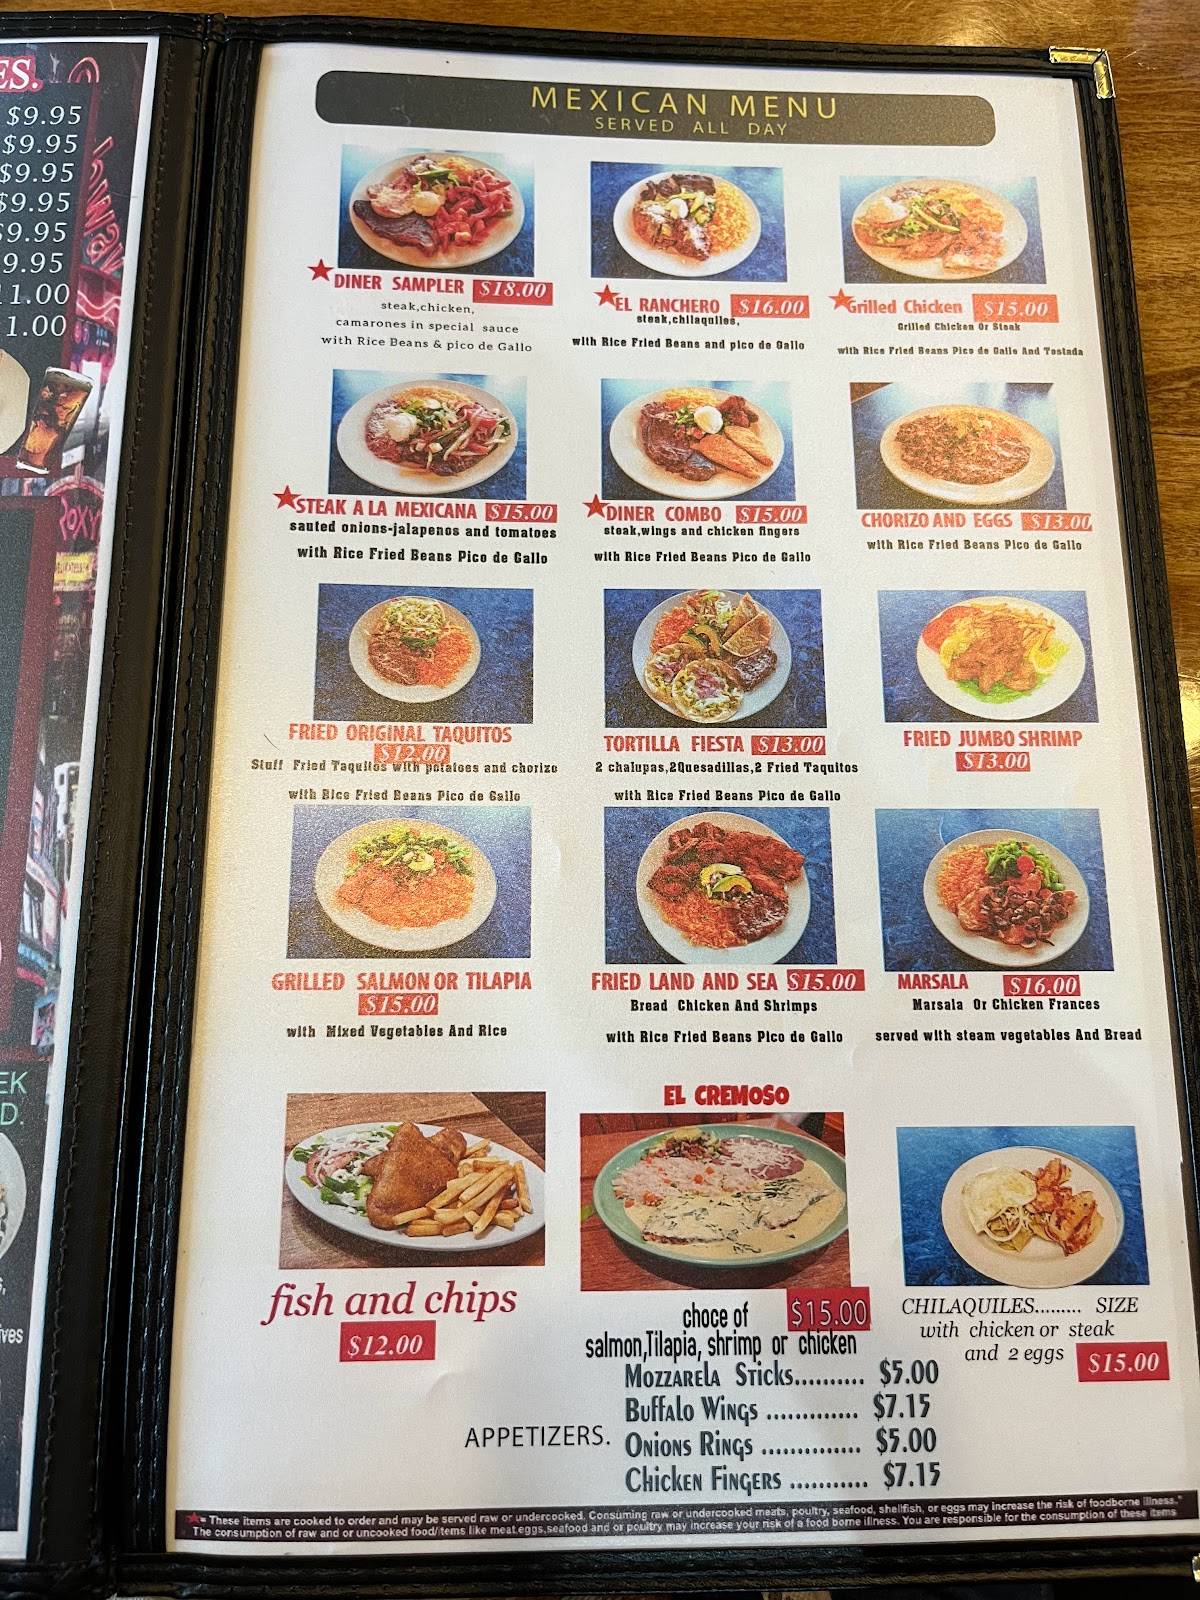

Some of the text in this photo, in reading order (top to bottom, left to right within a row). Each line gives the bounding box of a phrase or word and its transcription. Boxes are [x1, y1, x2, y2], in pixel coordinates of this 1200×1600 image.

[531, 85, 838, 119] MEXICAN MENU
[6, 106, 82, 126] $9.95
[595, 116, 788, 137] SERVED ALL DAY
[3, 134, 78, 155] $9.95
[0, 162, 75, 184] $9.95
[335, 273, 547, 299] DINER SAMPLER $18.00
[614, 297, 805, 315] EL RANCHERO $16.00
[846, 298, 1049, 317] Grilled Chicken $15.00
[335, 318, 520, 334] camarones in special sauce
[320, 335, 533, 353] with Rice Beans & pico de Gallo
[295, 497, 554, 521] STEAK A LA MEXICANA $15.00
[604, 503, 803, 523] DINER COMBO $15.00
[289, 520, 336, 533] sauted
[464, 524, 490, 538] and
[494, 525, 557, 539] tomatoes
[860, 511, 1093, 530] CHORIZO AND EGGS $13.00
[680, 524, 703, 537] and
[706, 525, 755, 537] chicken
[758, 525, 800, 539] fingers
[296, 545, 548, 565] with Rice Fried Beans Pico de Gallo
[288, 722, 513, 745] FRIED ORIGINAL TAQUITOS
[602, 734, 824, 753] TORTILLA FIESTA $13.00
[902, 729, 1083, 748] FRIED JUMBO SHRIMP
[595, 761, 603, 773] 2
[766, 761, 800, 774] Fried
[802, 761, 859, 776] Taquitos
[964, 752, 1029, 770] $13.00
[271, 971, 533, 992] GRILLED SALMON OR TILAPIA
[591, 971, 857, 992] FRIED LAND AND SEA $15.00
[897, 973, 1077, 995] MARSALA $16.00
[364, 994, 437, 1013] $15.00
[630, 998, 818, 1015] Bread Chicken And Shrimps
[286, 1023, 508, 1041] with Mixed Vegetables And Rice
[874, 1028, 1143, 1044] served with steam vegetables And Bread
[663, 1083, 791, 1107] EL CREMOSO
[260, 1280, 518, 1326] fish and chips
[682, 1298, 867, 1329] choce of $15.00
[1095, 1296, 1139, 1315] SIZE
[919, 1318, 1116, 1339] with chicken or steak
[347, 1334, 424, 1359] $12.00
[707, 1330, 763, 1363] shrimp
[771, 1333, 788, 1356] or
[798, 1330, 858, 1356] chicken
[964, 1346, 1160, 1374] and 2 eggs $15.00
[878, 1358, 940, 1389] $5.00
[872, 1392, 931, 1423] $7.15
[463, 1424, 611, 1449] APPETIZERS.
[875, 1425, 938, 1457] $5.00
[882, 1461, 941, 1492] $7.15
[208, 1514, 241, 1526] These
[242, 1515, 272, 1527] items
[273, 1517, 292, 1527] are
[293, 1515, 332, 1526] cooked
[334, 1516, 345, 1526] to
[347, 1515, 377, 1527] order
[377, 1514, 399, 1525] and
[400, 1515, 424, 1527] may
[425, 1513, 440, 1525] be
[441, 1512, 477, 1524] served
[479, 1514, 499, 1523] raw
[500, 1514, 514, 1523] or
[588, 1509, 648, 1522] Consuming
